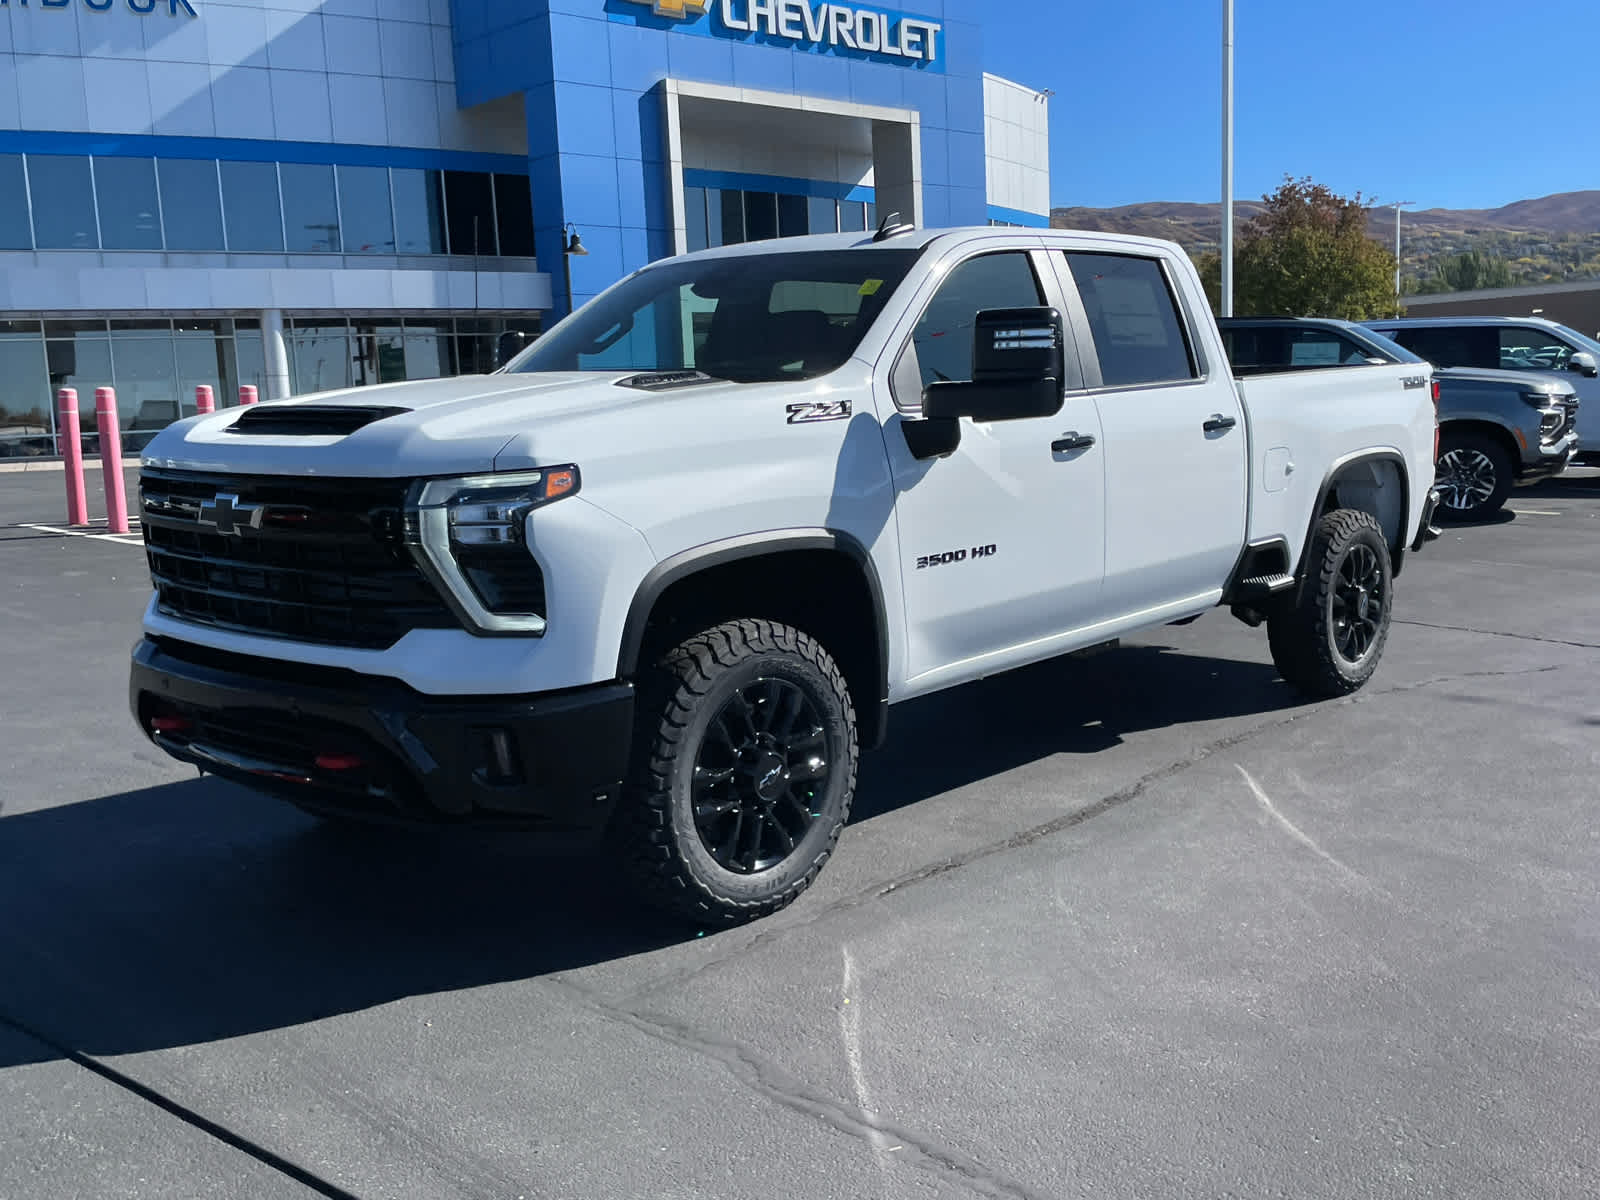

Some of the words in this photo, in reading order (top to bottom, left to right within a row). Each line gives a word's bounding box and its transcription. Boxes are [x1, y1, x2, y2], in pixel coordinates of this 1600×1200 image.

[722, 0, 941, 60] CHEVROLET
[786, 400, 853, 424] Z71
[916, 550, 967, 569] 3500
[971, 544, 997, 559] HD
